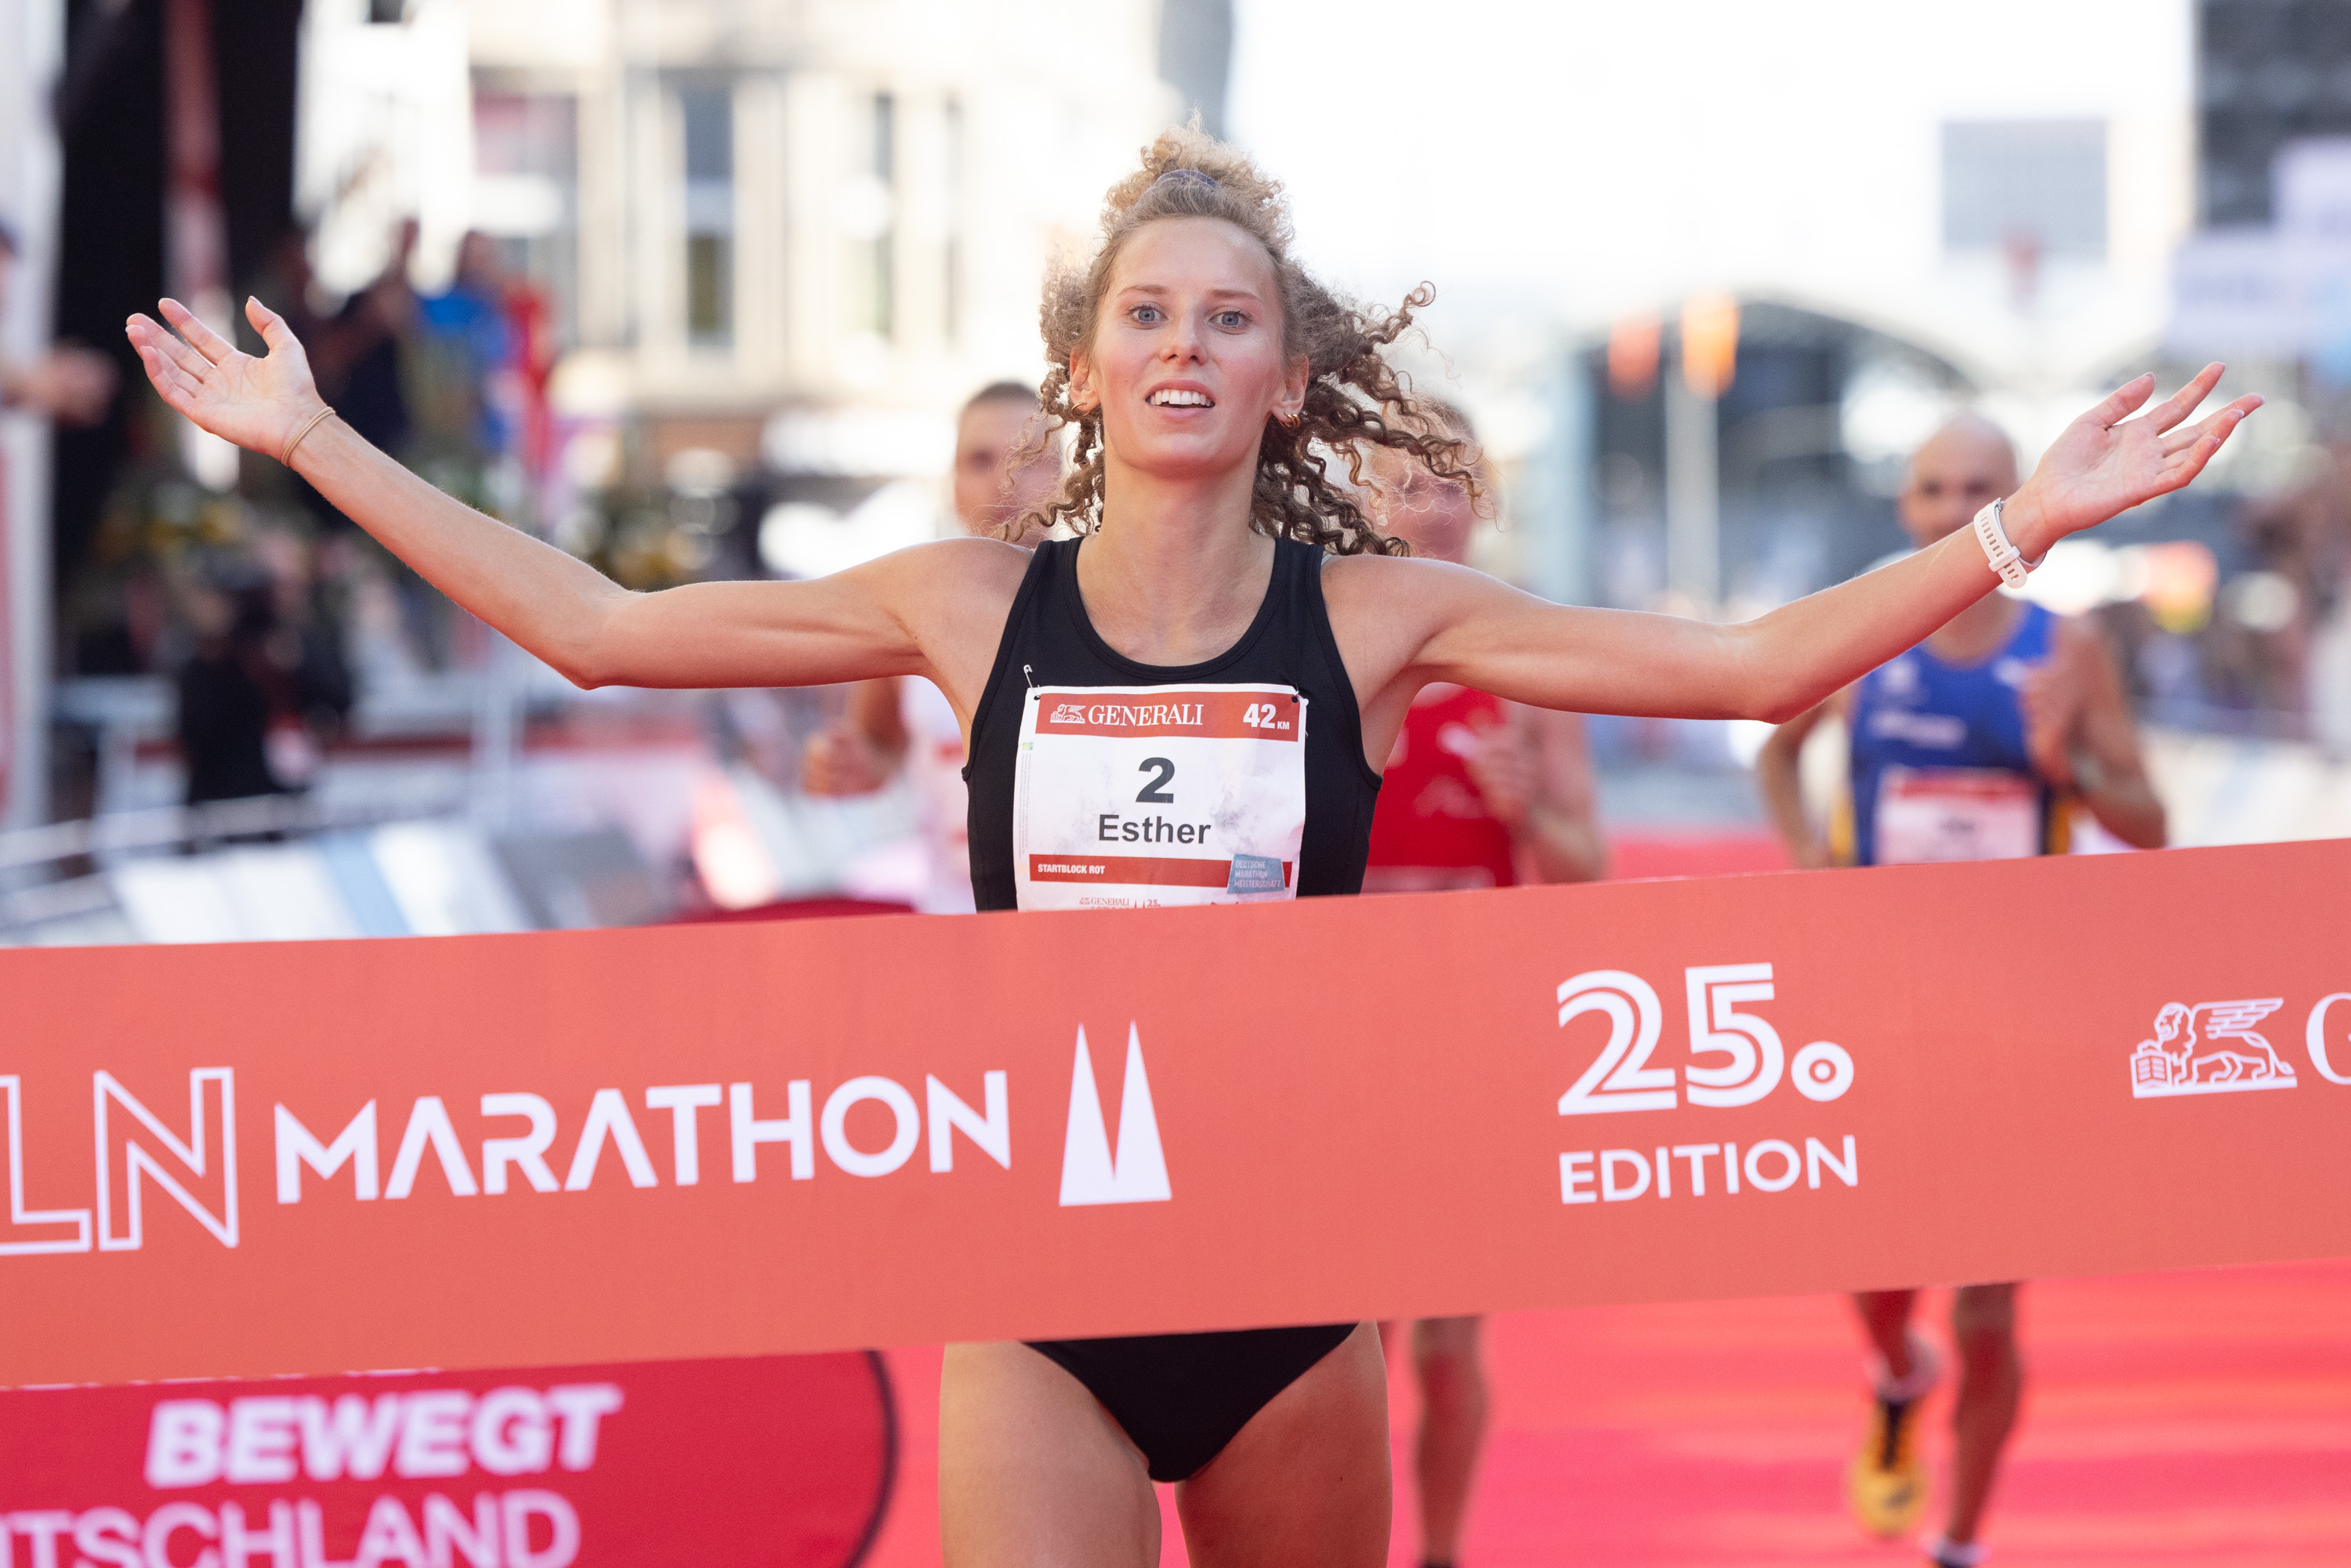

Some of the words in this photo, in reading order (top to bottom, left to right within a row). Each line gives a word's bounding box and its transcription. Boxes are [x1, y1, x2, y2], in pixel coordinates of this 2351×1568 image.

[1088, 704, 1204, 726] GENERALI
[1244, 704, 1277, 729] 42
[1277, 721, 1290, 730] KM
[1136, 757, 1176, 804] 2
[1099, 814, 1212, 845] Esther
[1038, 864, 1087, 875] STARTBLOCK
[1089, 865, 1105, 875] ROT
[1234, 870, 1268, 878] MARATHON
[1235, 860, 1266, 869] DEUTSCHE
[1233, 879, 1281, 888] MEISTERSCHAFT
[1091, 897, 1129, 907] GENERALI
[274, 1070, 1011, 1204] MARATHON
[1559, 1135, 1859, 1204] EDITION
[144, 1382, 625, 1490] BEWEGT
[0, 1488, 582, 1568] TSCHLAND
